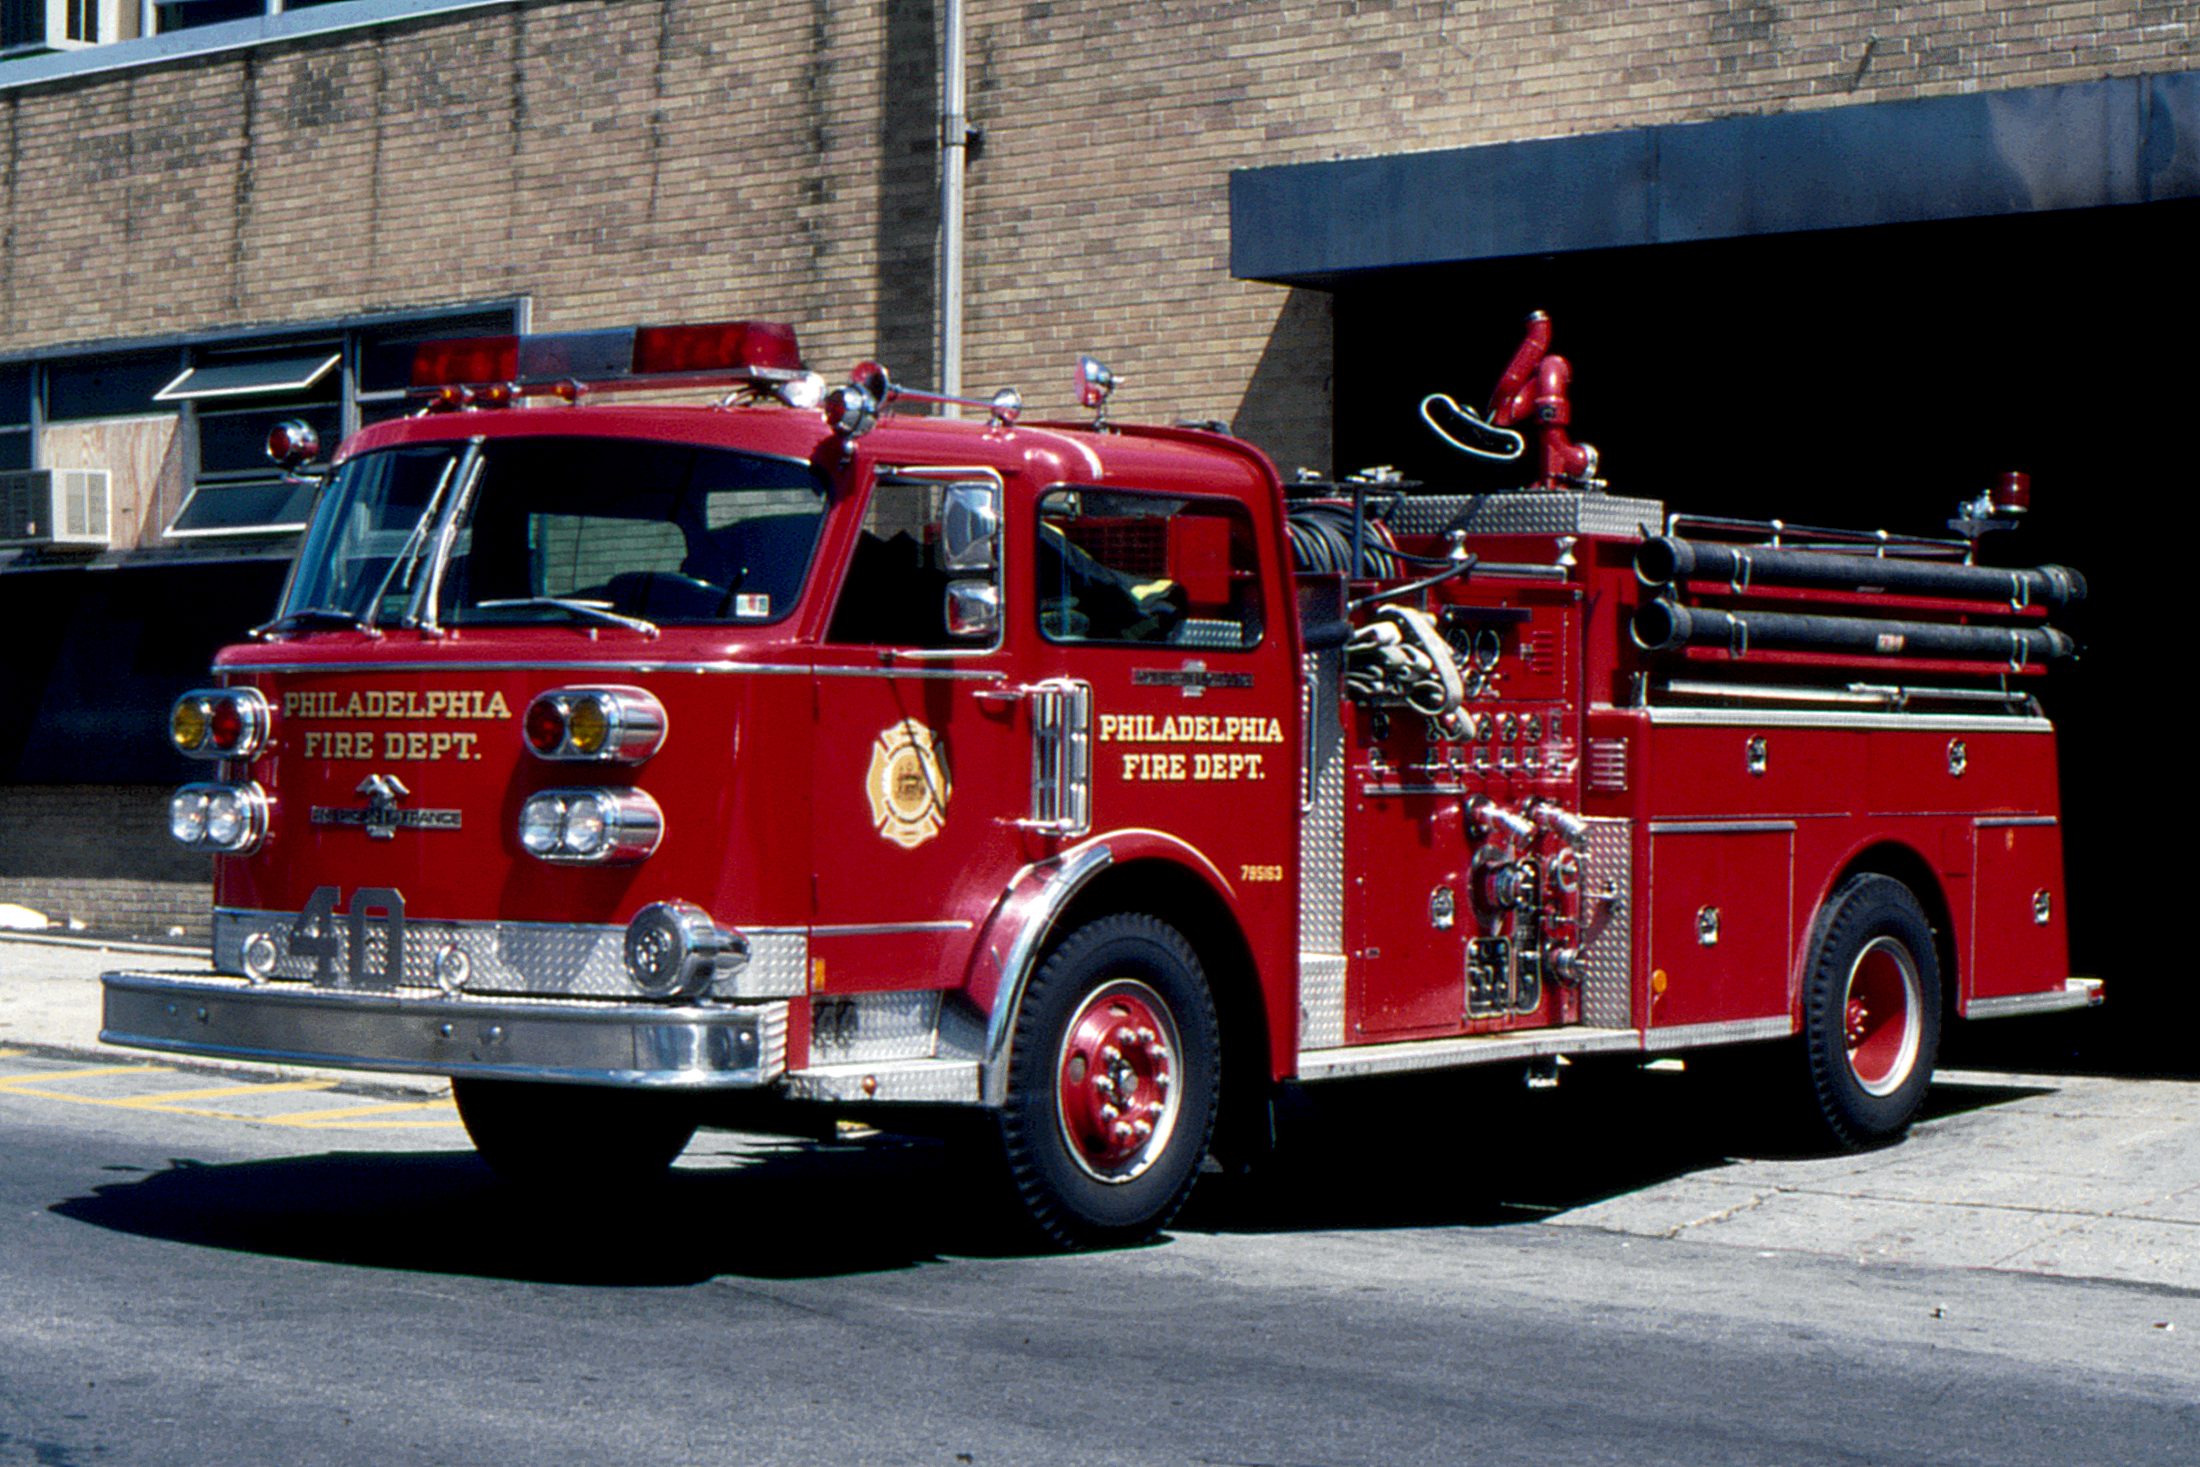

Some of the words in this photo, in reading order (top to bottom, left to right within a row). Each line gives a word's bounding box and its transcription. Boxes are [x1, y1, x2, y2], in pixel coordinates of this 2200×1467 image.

[283, 691, 513, 719] PHILADELPHIA
[1099, 714, 1285, 744] PHILADELPHIA
[304, 732, 375, 760] FIRE
[383, 732, 482, 761] DEPT.
[1122, 753, 1187, 781] FIRE
[1193, 753, 1267, 781] DEPT.
[290, 886, 405, 989] 40
